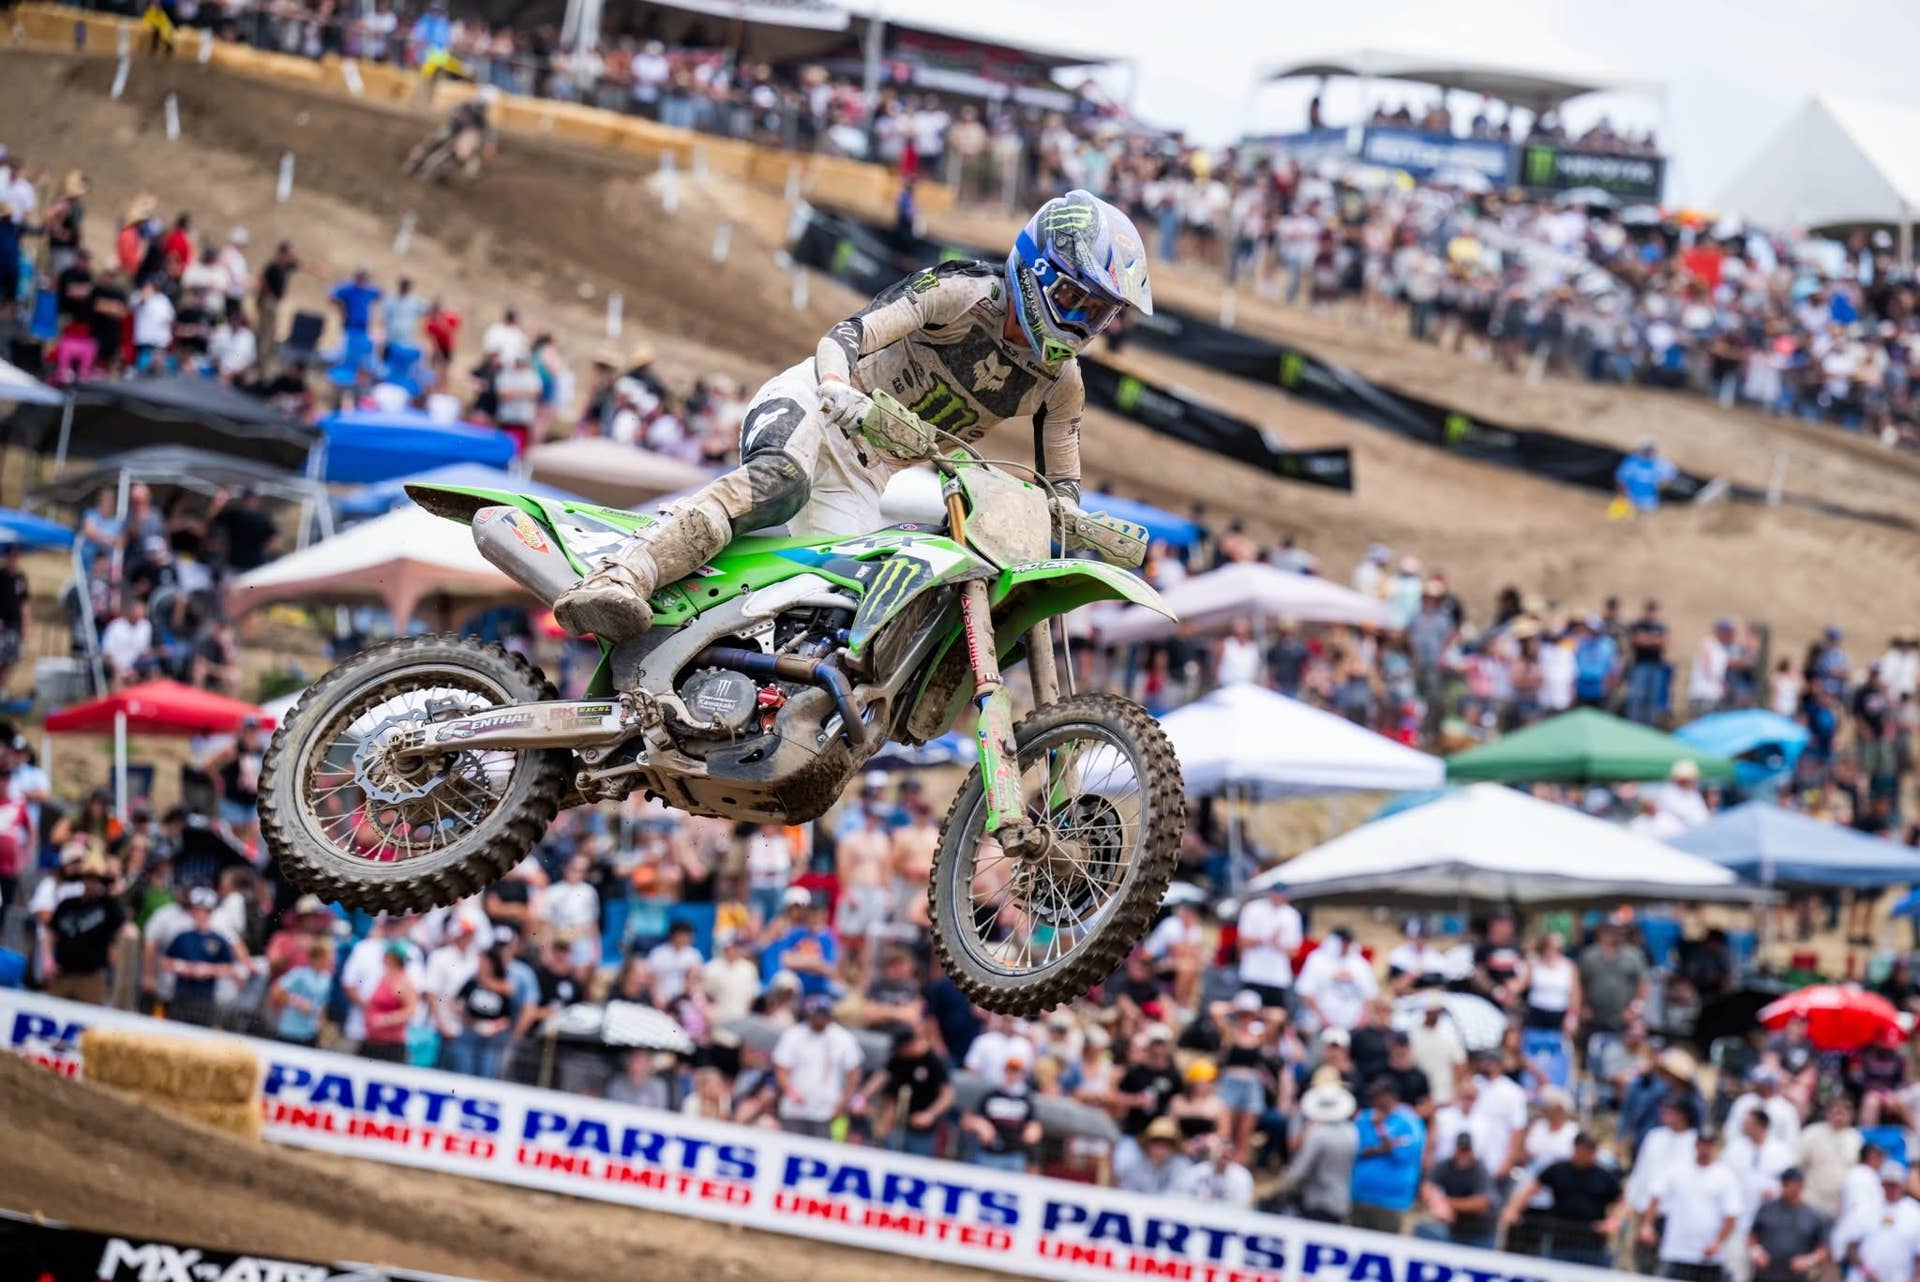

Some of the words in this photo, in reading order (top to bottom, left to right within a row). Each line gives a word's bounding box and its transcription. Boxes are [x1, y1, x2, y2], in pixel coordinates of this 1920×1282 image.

[262, 1098, 497, 1159] UNLIMITED
[517, 1146, 753, 1206] UNLIMITED
[774, 1191, 1013, 1252] UNLIMITED
[264, 1063, 500, 1133] PARTS
[522, 1109, 757, 1180] PARTS
[783, 1155, 1020, 1226] PARTS
[1043, 1200, 1286, 1269] PARTS
